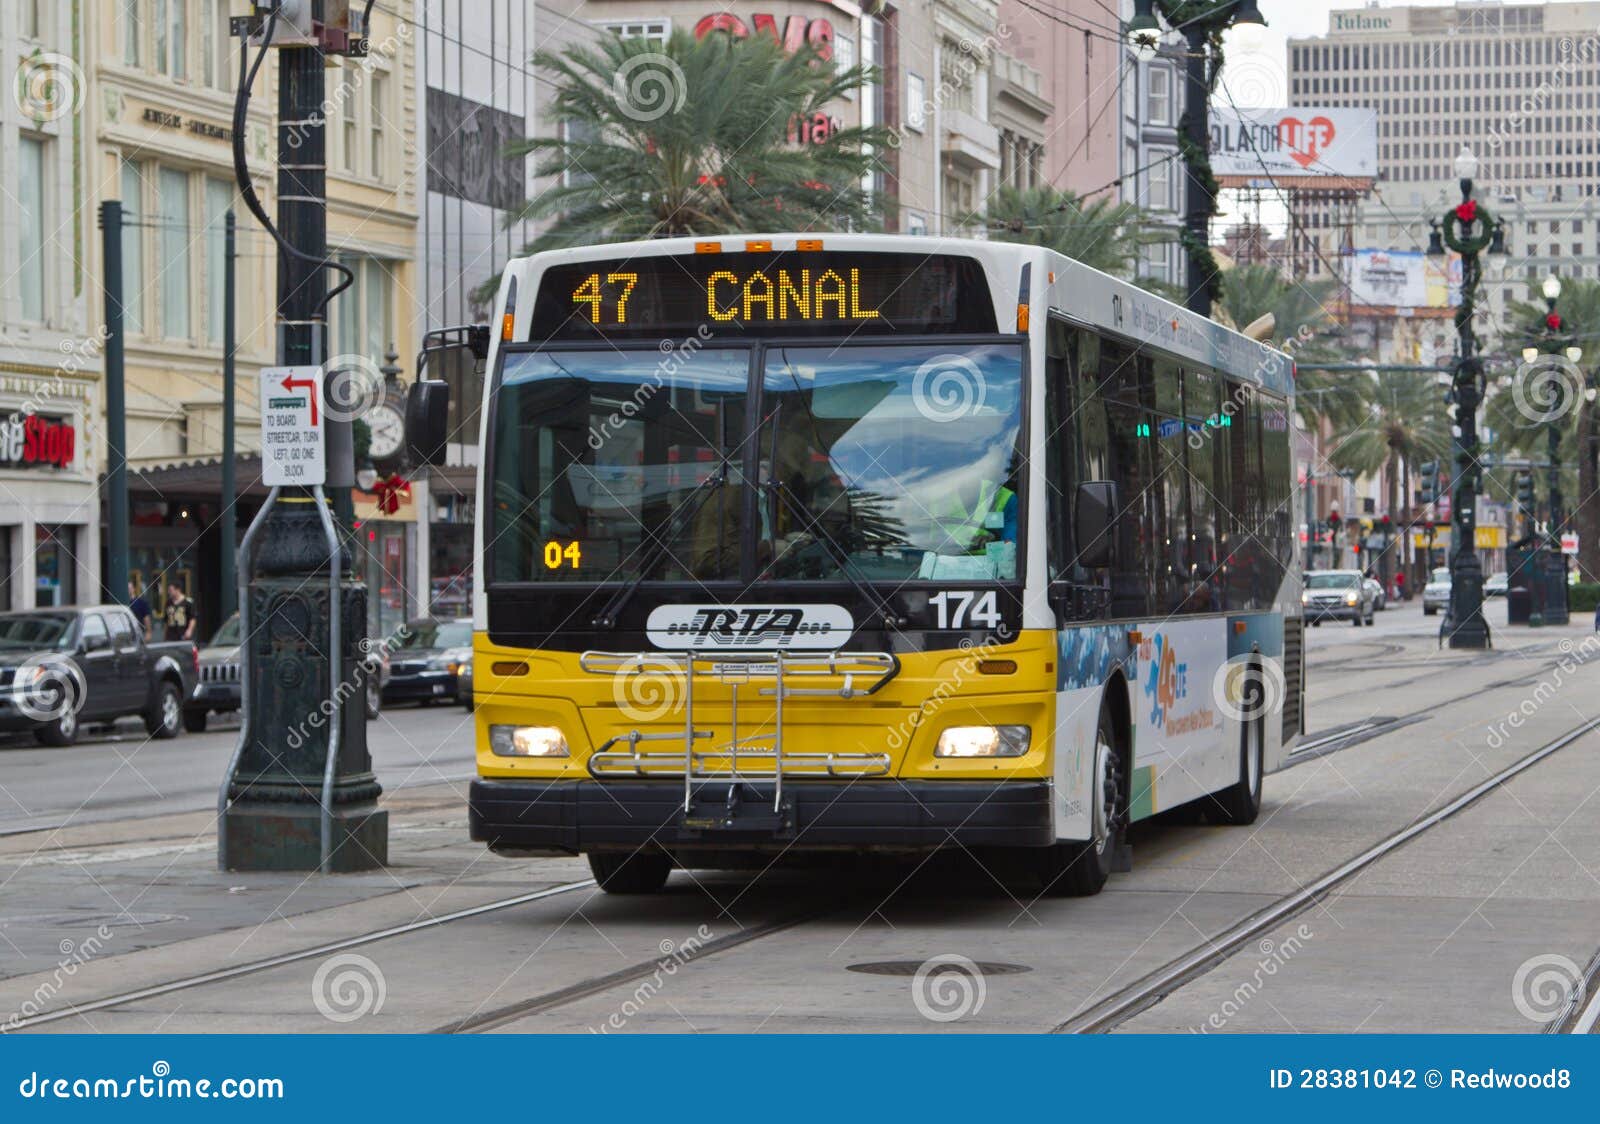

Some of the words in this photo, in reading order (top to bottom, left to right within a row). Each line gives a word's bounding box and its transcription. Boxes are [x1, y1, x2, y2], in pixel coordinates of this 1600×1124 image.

[1332, 13, 1393, 31] Tulane
[572, 272, 638, 324] 47
[706, 268, 880, 321] CANAL
[267, 415, 275, 426] TO
[276, 415, 296, 426] BOARD
[303, 432, 319, 442] TURN
[291, 448, 300, 460] GO
[302, 448, 314, 459] ONE
[284, 465, 304, 477] BLOCK
[544, 540, 581, 569] 04
[928, 591, 1002, 629] 174
[694, 608, 804, 646] RTA
[1176, 663, 1187, 699] LTE
